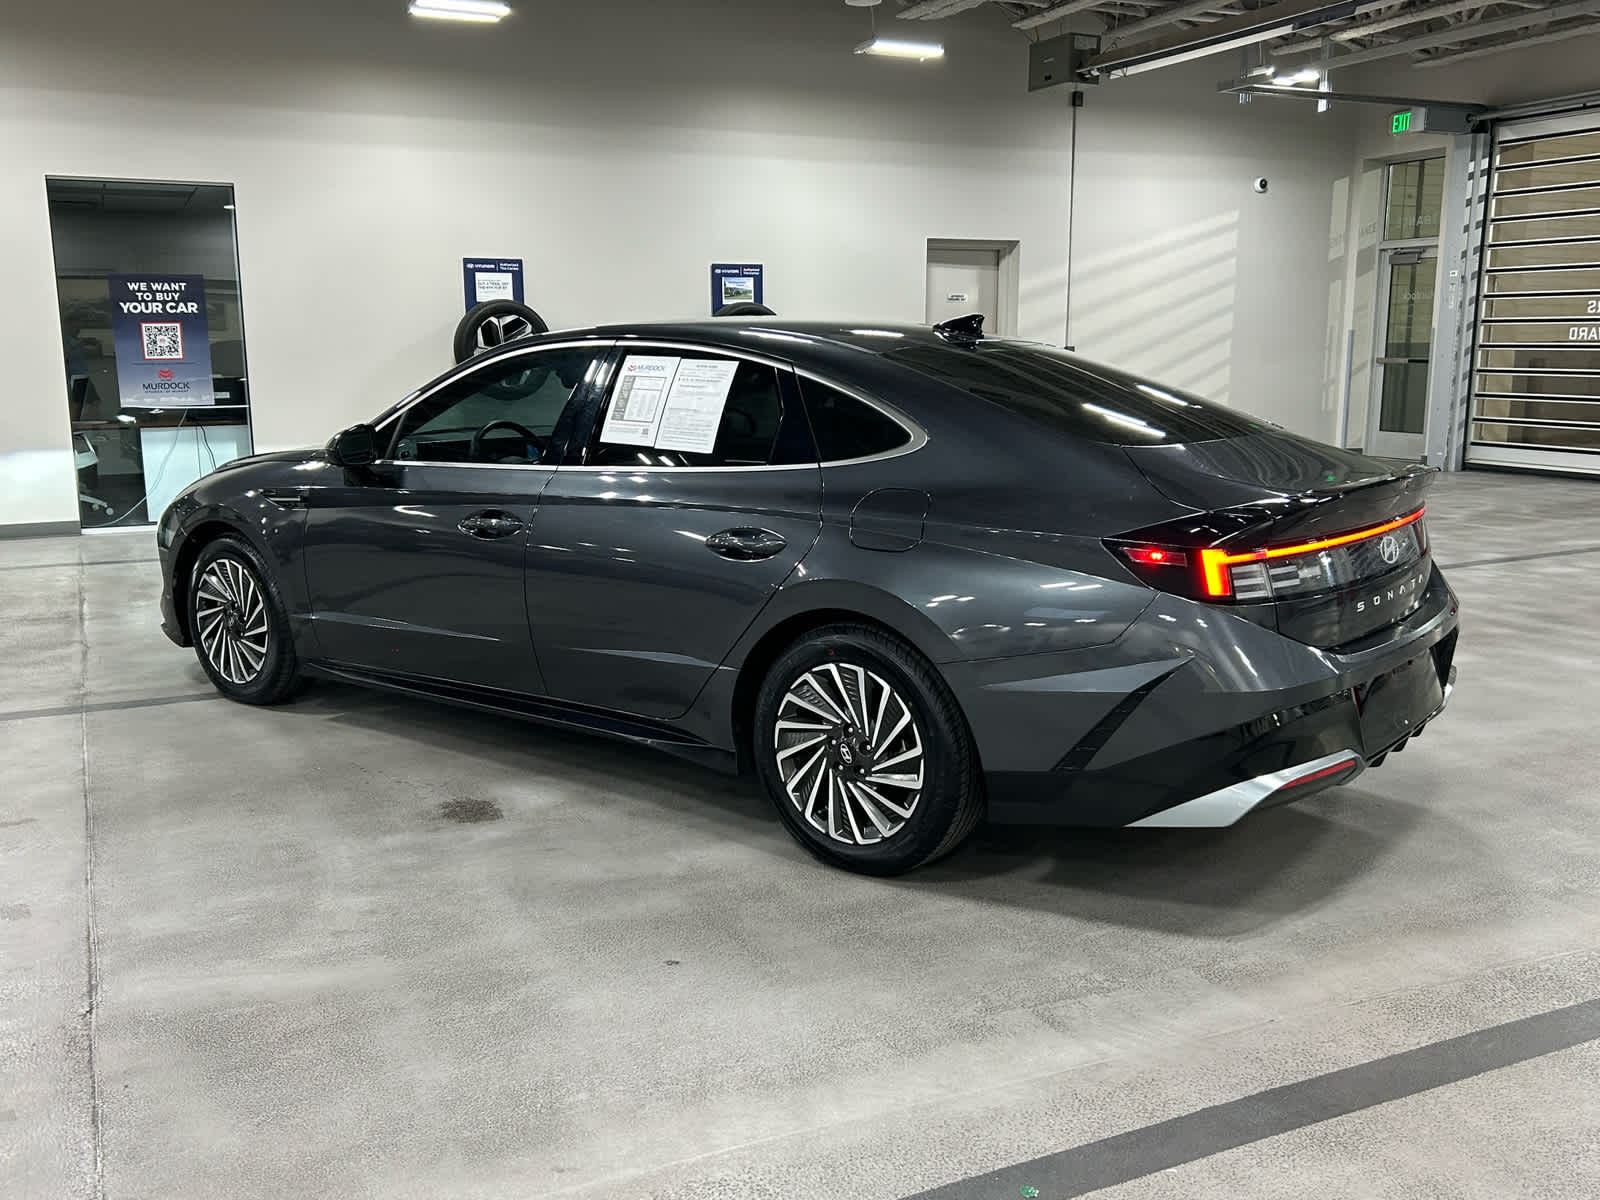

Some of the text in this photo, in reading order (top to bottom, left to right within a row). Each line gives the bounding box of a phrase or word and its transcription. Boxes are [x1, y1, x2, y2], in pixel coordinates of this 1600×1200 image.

[1392, 112, 1411, 133] EXIT
[127, 282, 187, 291] WE WANT
[136, 292, 180, 301] TO BUY
[119, 302, 199, 314] YOUR CAR
[142, 381, 191, 390] MURDOCK
[1356, 574, 1424, 612] SONATA
